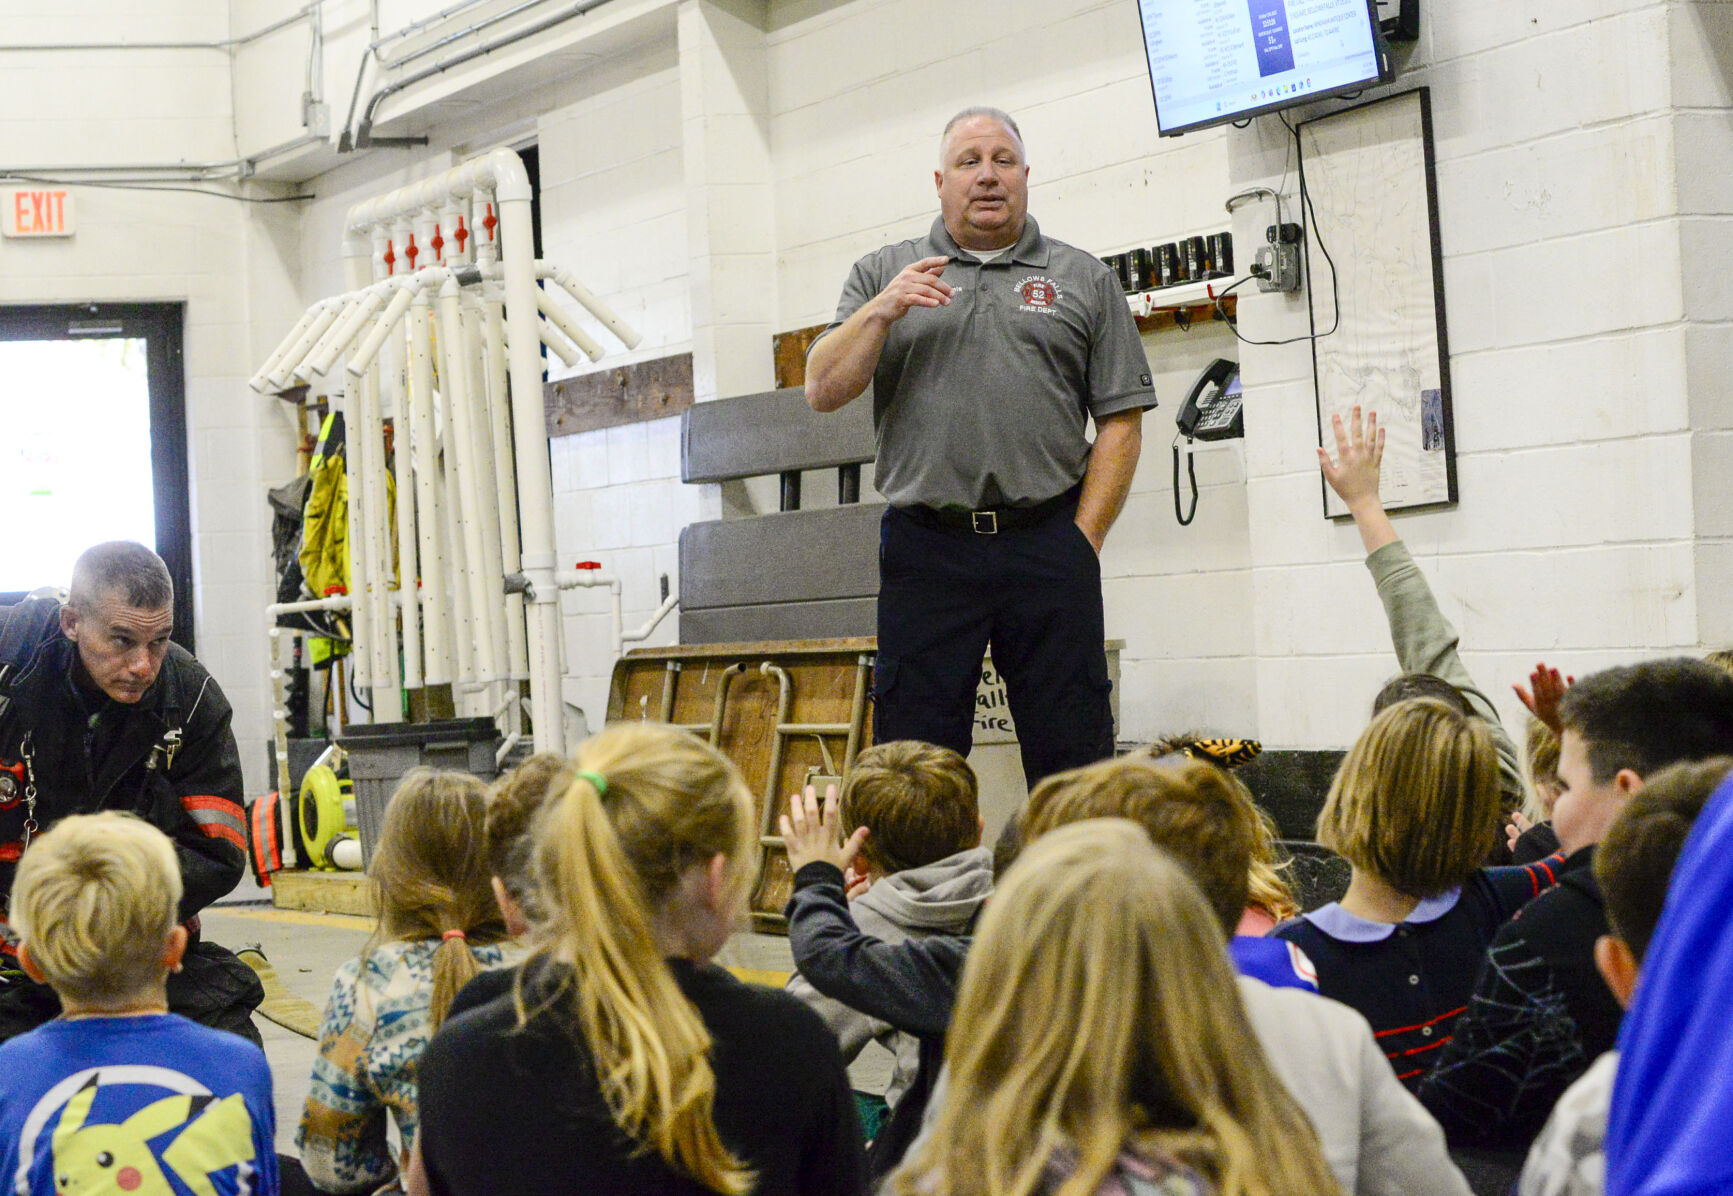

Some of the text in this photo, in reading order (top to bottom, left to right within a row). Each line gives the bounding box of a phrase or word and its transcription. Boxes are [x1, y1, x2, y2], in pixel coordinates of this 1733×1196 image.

[15, 191, 67, 232] EXIT
[1013, 275, 1045, 292] BELLOWS
[1032, 289, 1045, 299] 52
[1037, 306, 1057, 316] DEPT
[976, 688, 1007, 709] all
